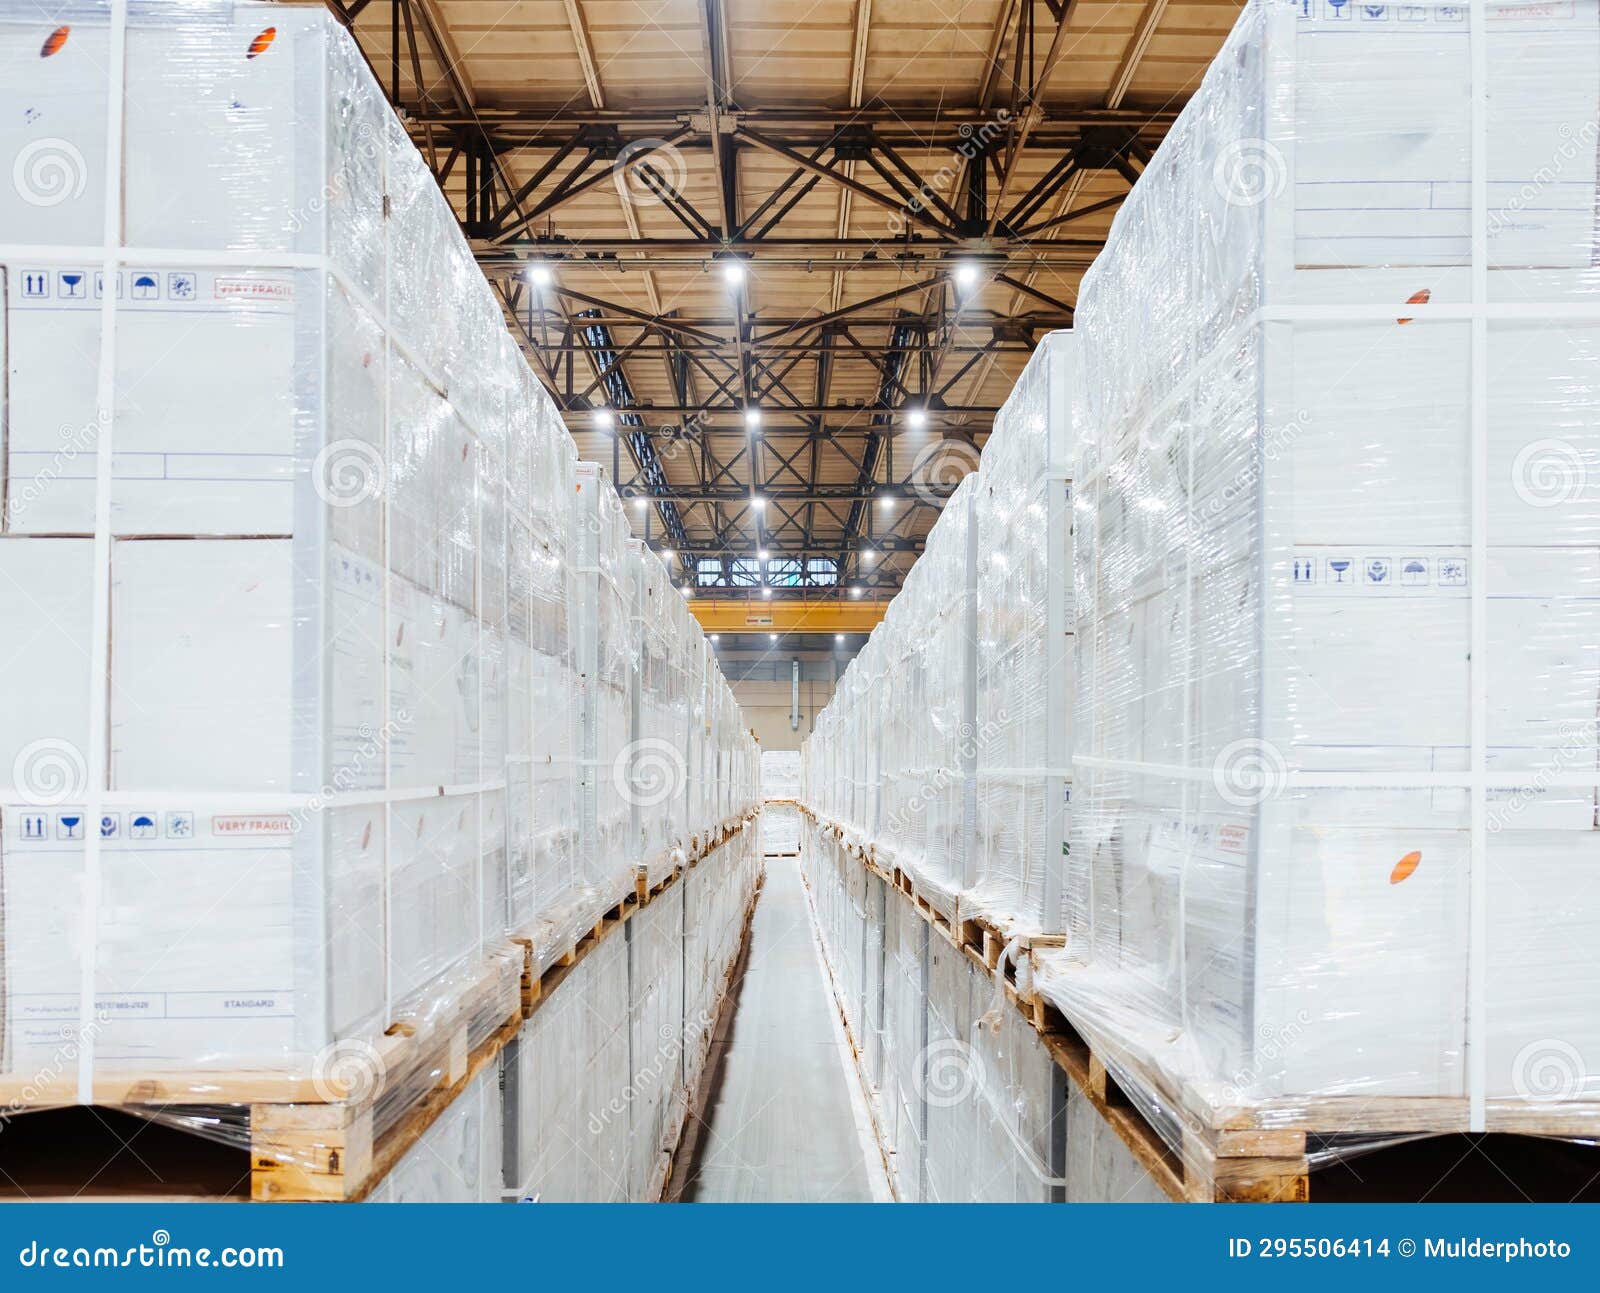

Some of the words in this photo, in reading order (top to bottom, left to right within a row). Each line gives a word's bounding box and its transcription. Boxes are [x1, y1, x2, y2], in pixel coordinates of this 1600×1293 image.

[252, 284, 293, 295] FRAGIL
[217, 820, 247, 831] VERY
[249, 820, 292, 831] FRAGIL
[224, 999, 275, 1009] STANDARD
